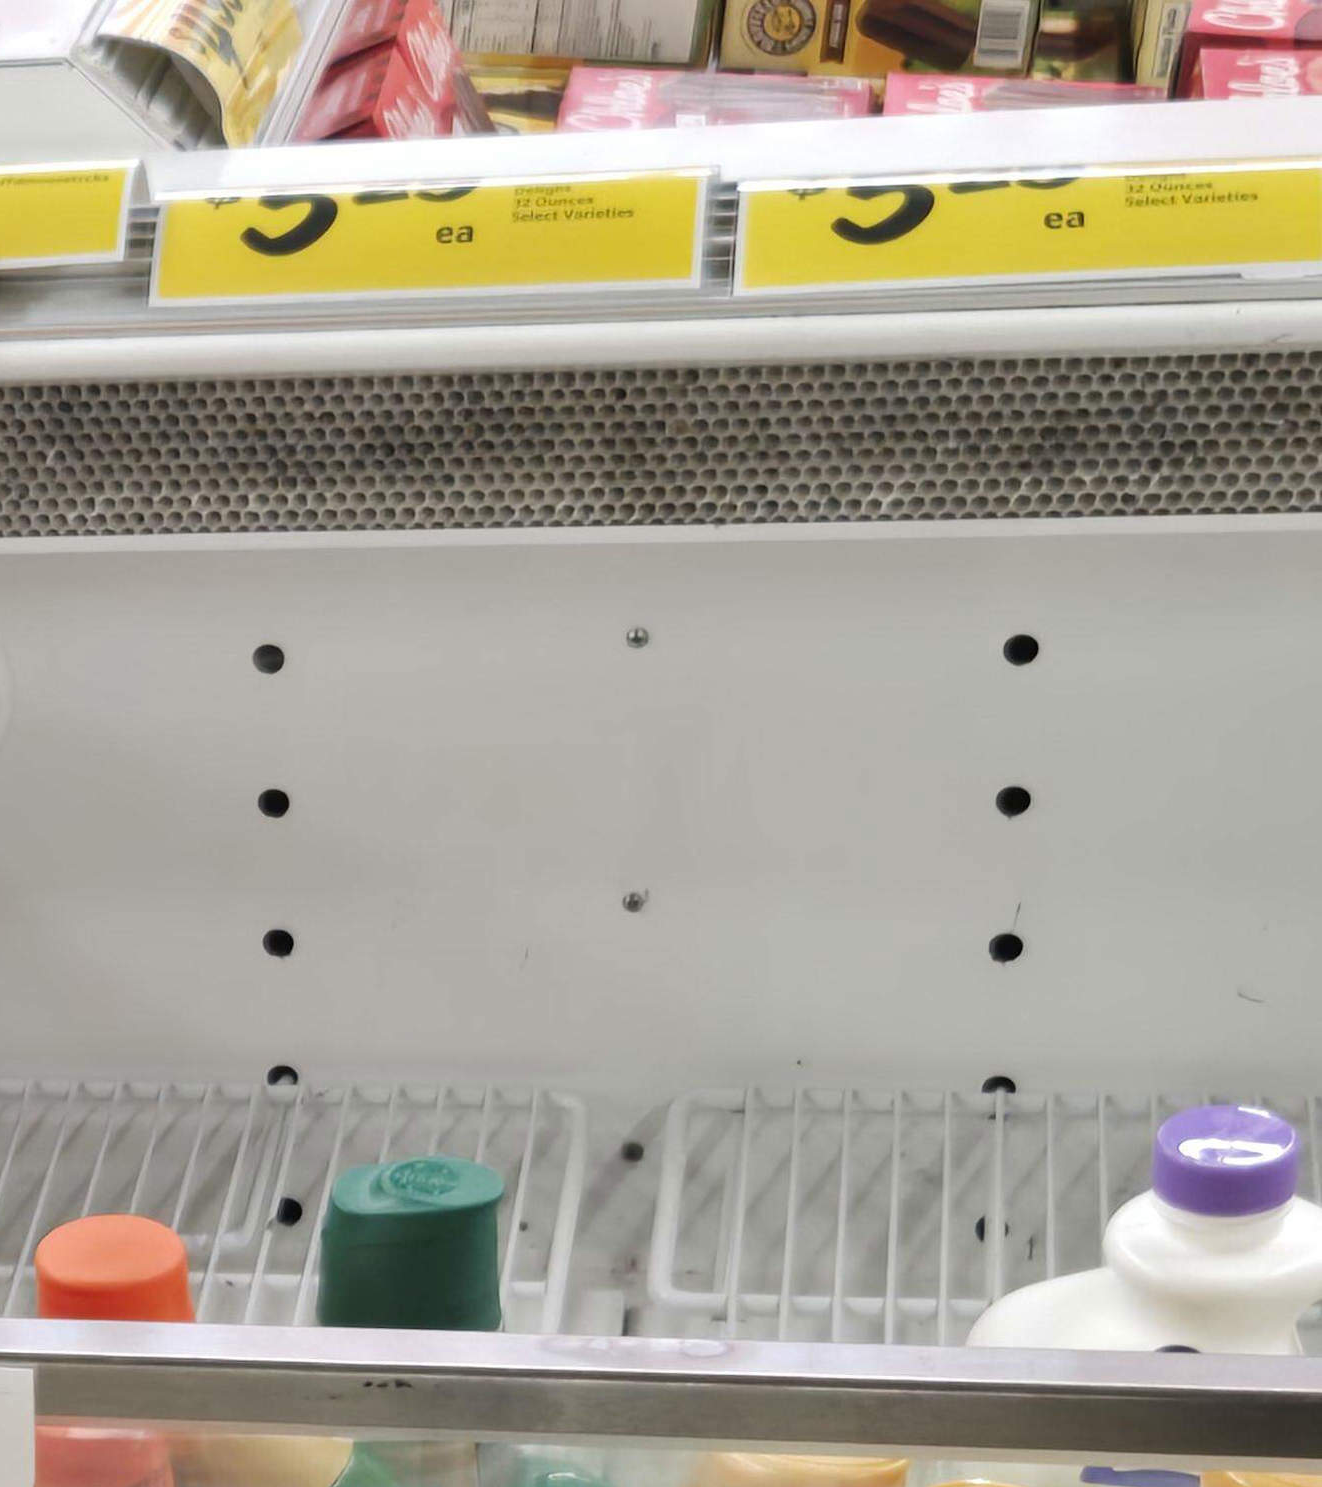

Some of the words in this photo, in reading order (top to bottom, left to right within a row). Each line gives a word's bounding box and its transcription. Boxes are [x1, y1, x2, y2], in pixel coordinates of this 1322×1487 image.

[1150, 182, 1214, 193] Ounces
[536, 197, 594, 207] Ounces
[1125, 195, 1176, 207] Select
[1182, 192, 1260, 204] Varieties
[512, 210, 558, 223] Select
[564, 208, 635, 220] Varieties
[1043, 209, 1085, 230] ea
[435, 224, 474, 244] ea
